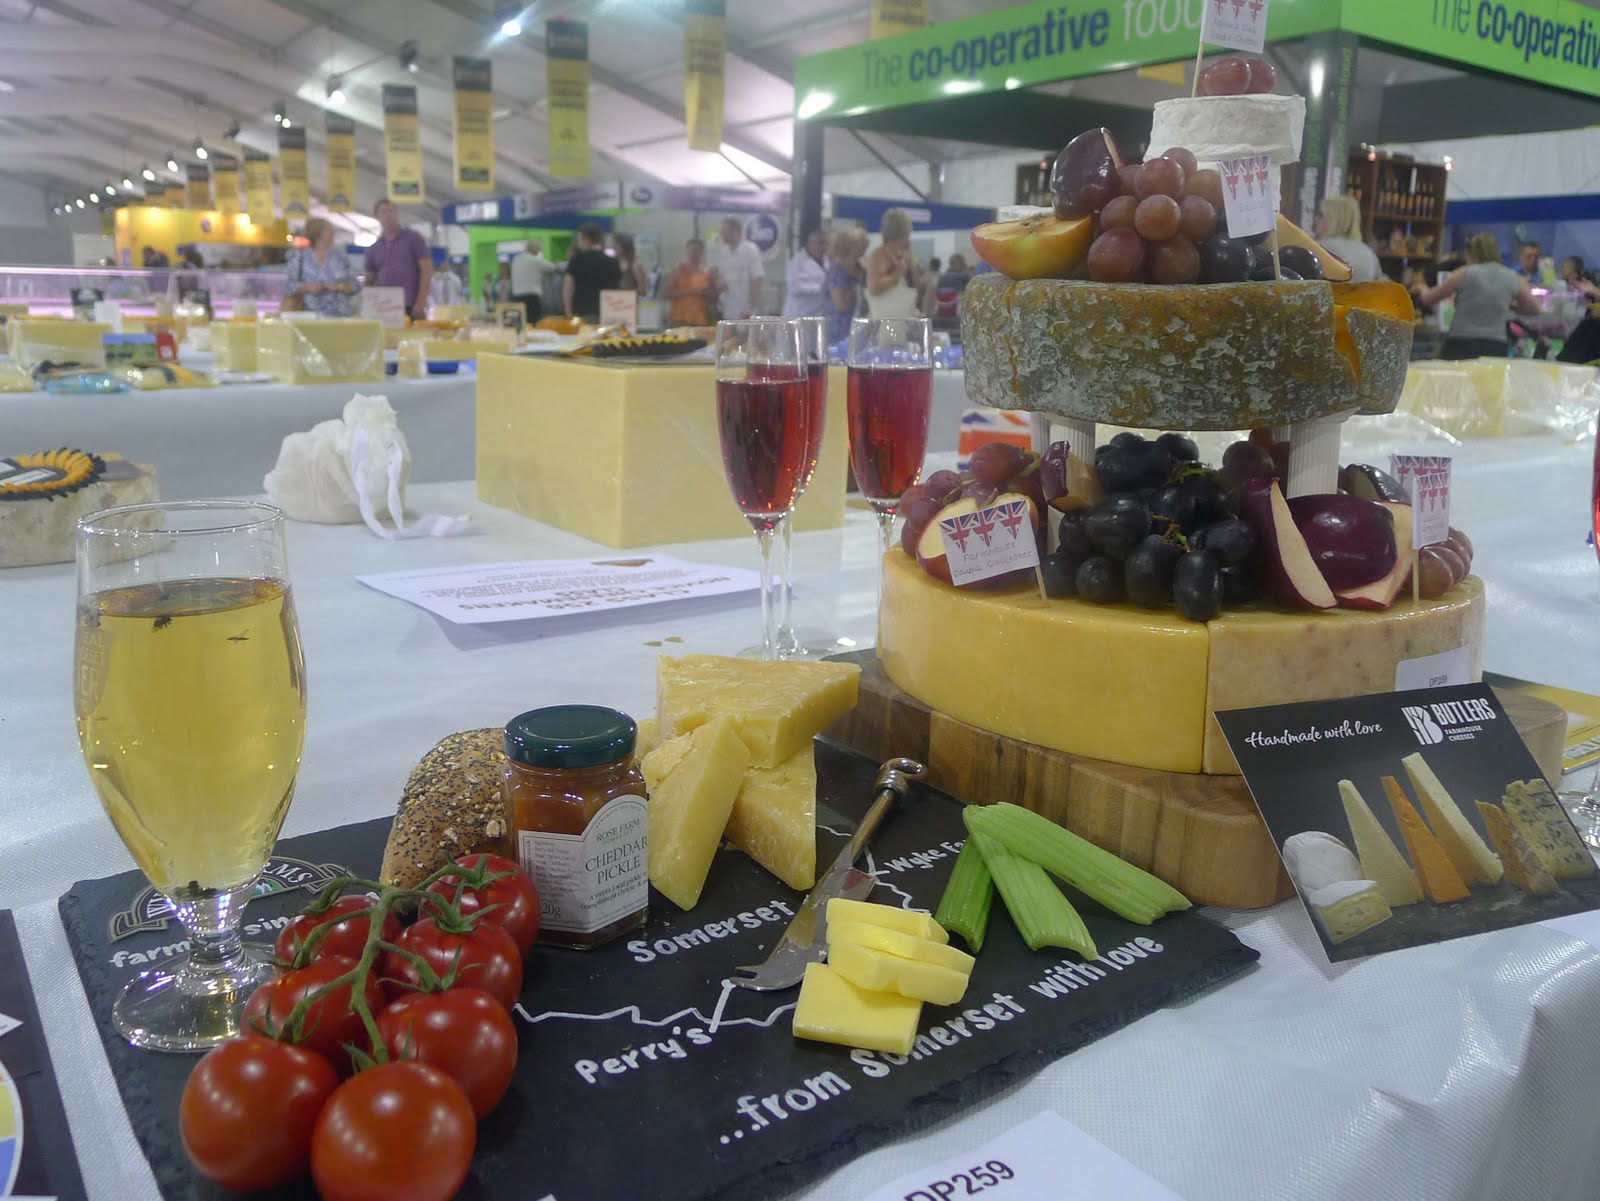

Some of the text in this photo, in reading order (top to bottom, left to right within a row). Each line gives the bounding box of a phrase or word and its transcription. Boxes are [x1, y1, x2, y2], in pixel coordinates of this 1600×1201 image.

[863, 49, 901, 91] The
[908, 7, 1111, 79] co-operative
[1477, 0, 1600, 70] co-operativ
[1429, 697, 1497, 726] BUTLERS
[1244, 719, 1383, 749] Handmade with love
[1444, 724, 1484, 736] FARMHOUSE
[1448, 733, 1476, 742] CHEESES
[596, 817, 640, 843] ROSE FARM
[585, 836, 648, 873] CHEDDAR
[883, 849, 948, 872] Wyke
[597, 855, 641, 885] PICKLE
[627, 900, 795, 963] Somerset
[1028, 960, 1107, 999] with
[1096, 936, 1164, 971] love
[574, 1026, 713, 1084] Perry's
